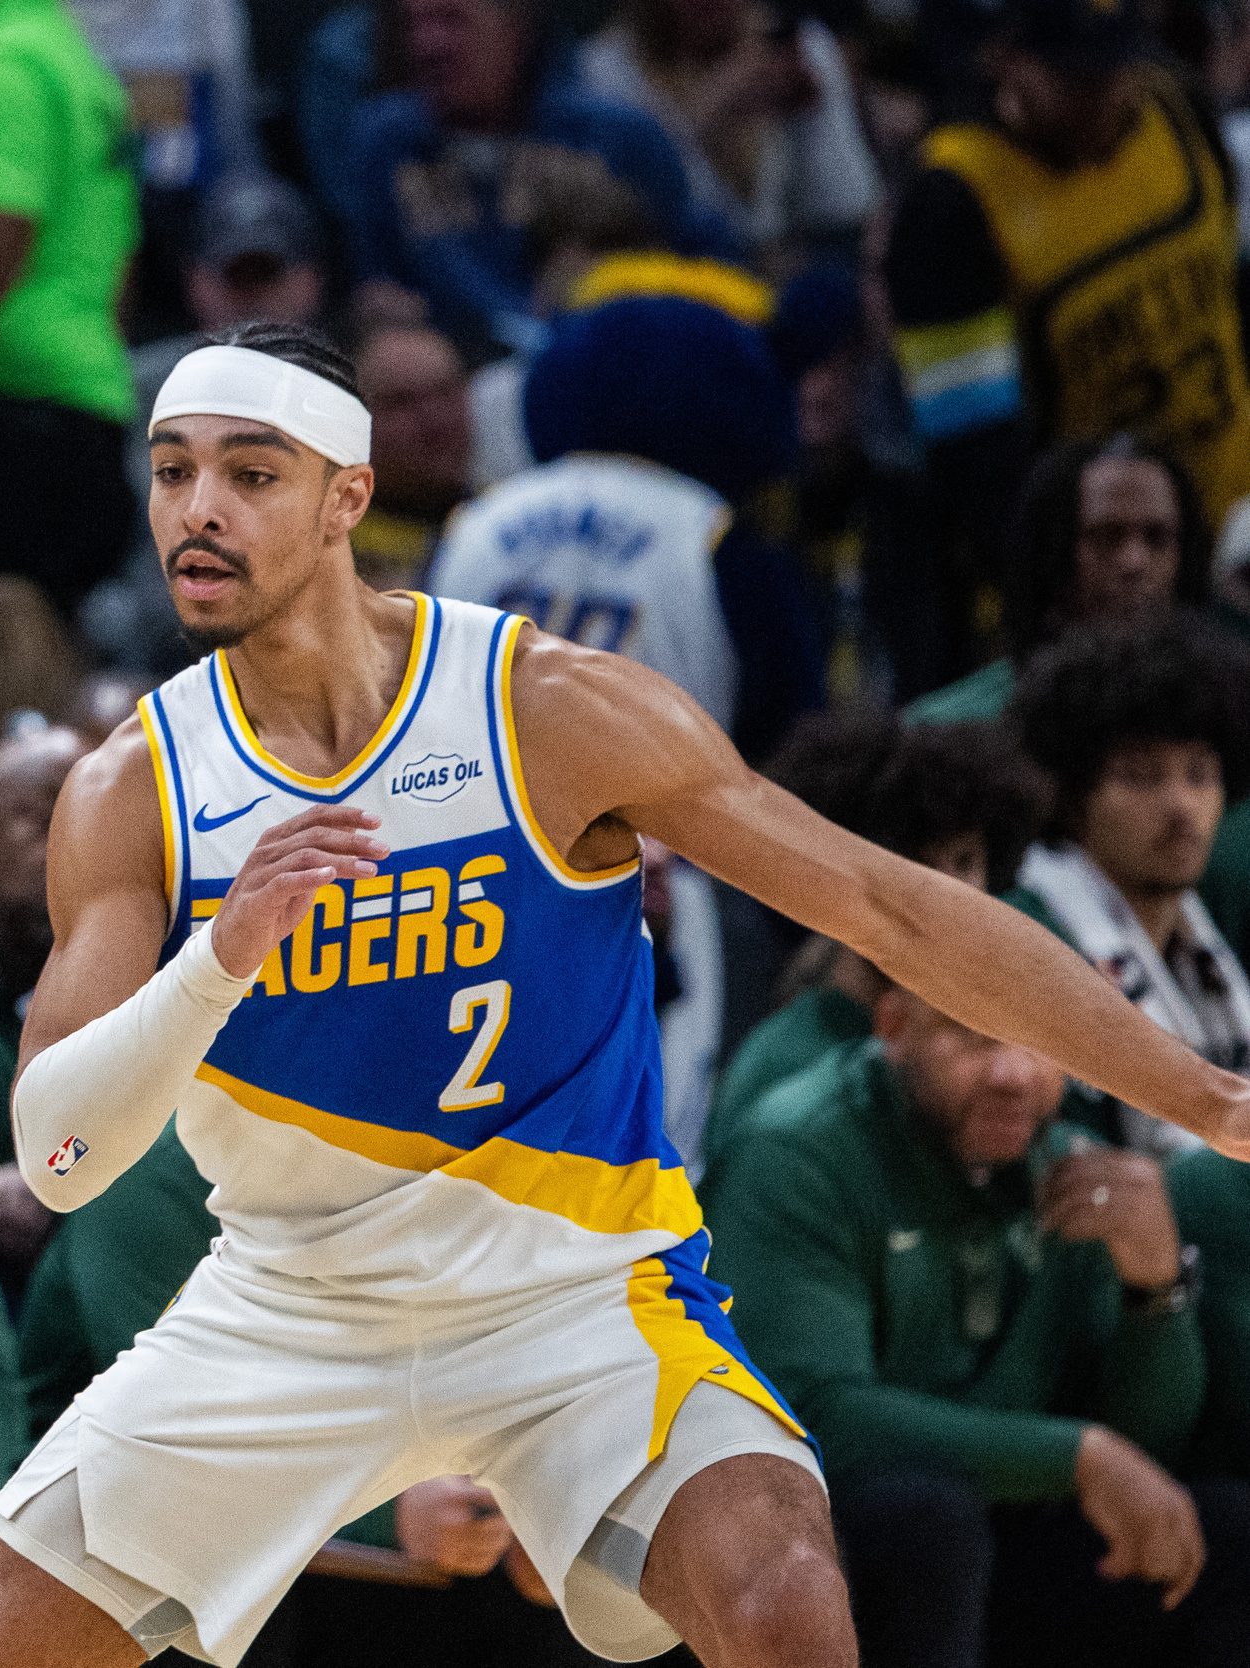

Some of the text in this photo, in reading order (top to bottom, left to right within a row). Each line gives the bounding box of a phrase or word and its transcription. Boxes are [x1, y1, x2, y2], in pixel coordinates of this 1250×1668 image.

[391, 760, 483, 795] LUCAS OIL
[438, 979, 512, 1112] 2
